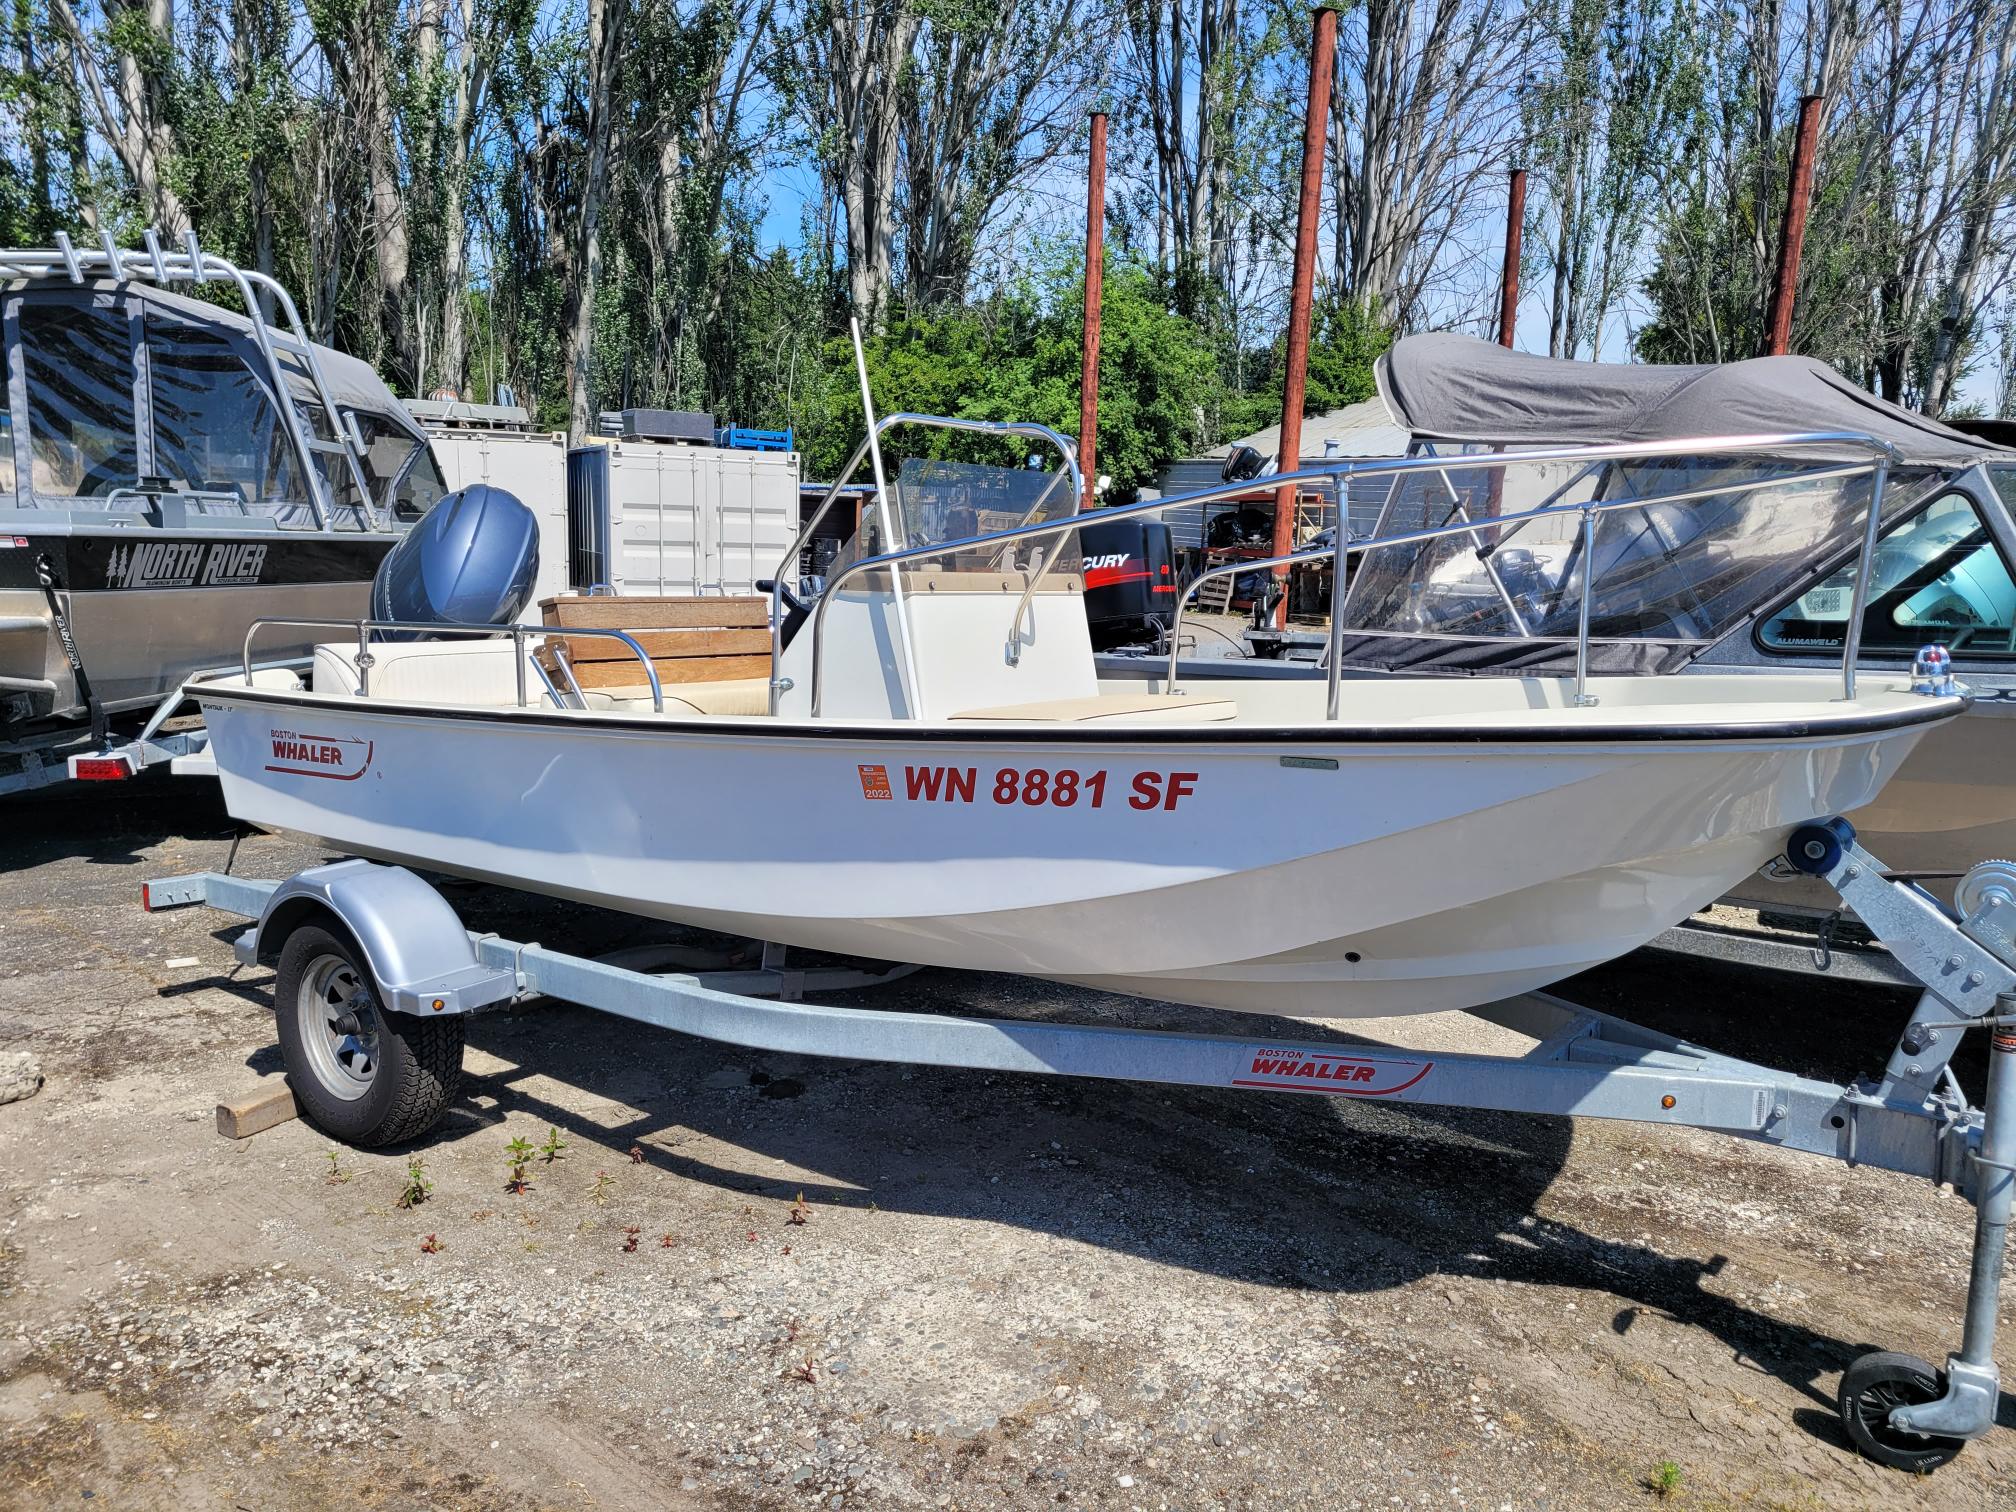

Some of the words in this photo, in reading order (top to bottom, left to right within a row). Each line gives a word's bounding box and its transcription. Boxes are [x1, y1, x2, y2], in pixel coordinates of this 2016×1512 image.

[122, 543, 205, 588] NORTH
[200, 543, 268, 585] RIVER
[1775, 637, 1839, 646] ALUMAWELD
[270, 729, 297, 740] BOSTON
[272, 740, 343, 766] WHALER
[865, 789, 891, 798] 2022
[904, 765, 978, 803] WN
[992, 767, 1108, 809] 8881
[1128, 771, 1199, 811] SF
[1257, 1049, 1305, 1059] BOSTON
[1251, 1058, 1376, 1083] WHALER
